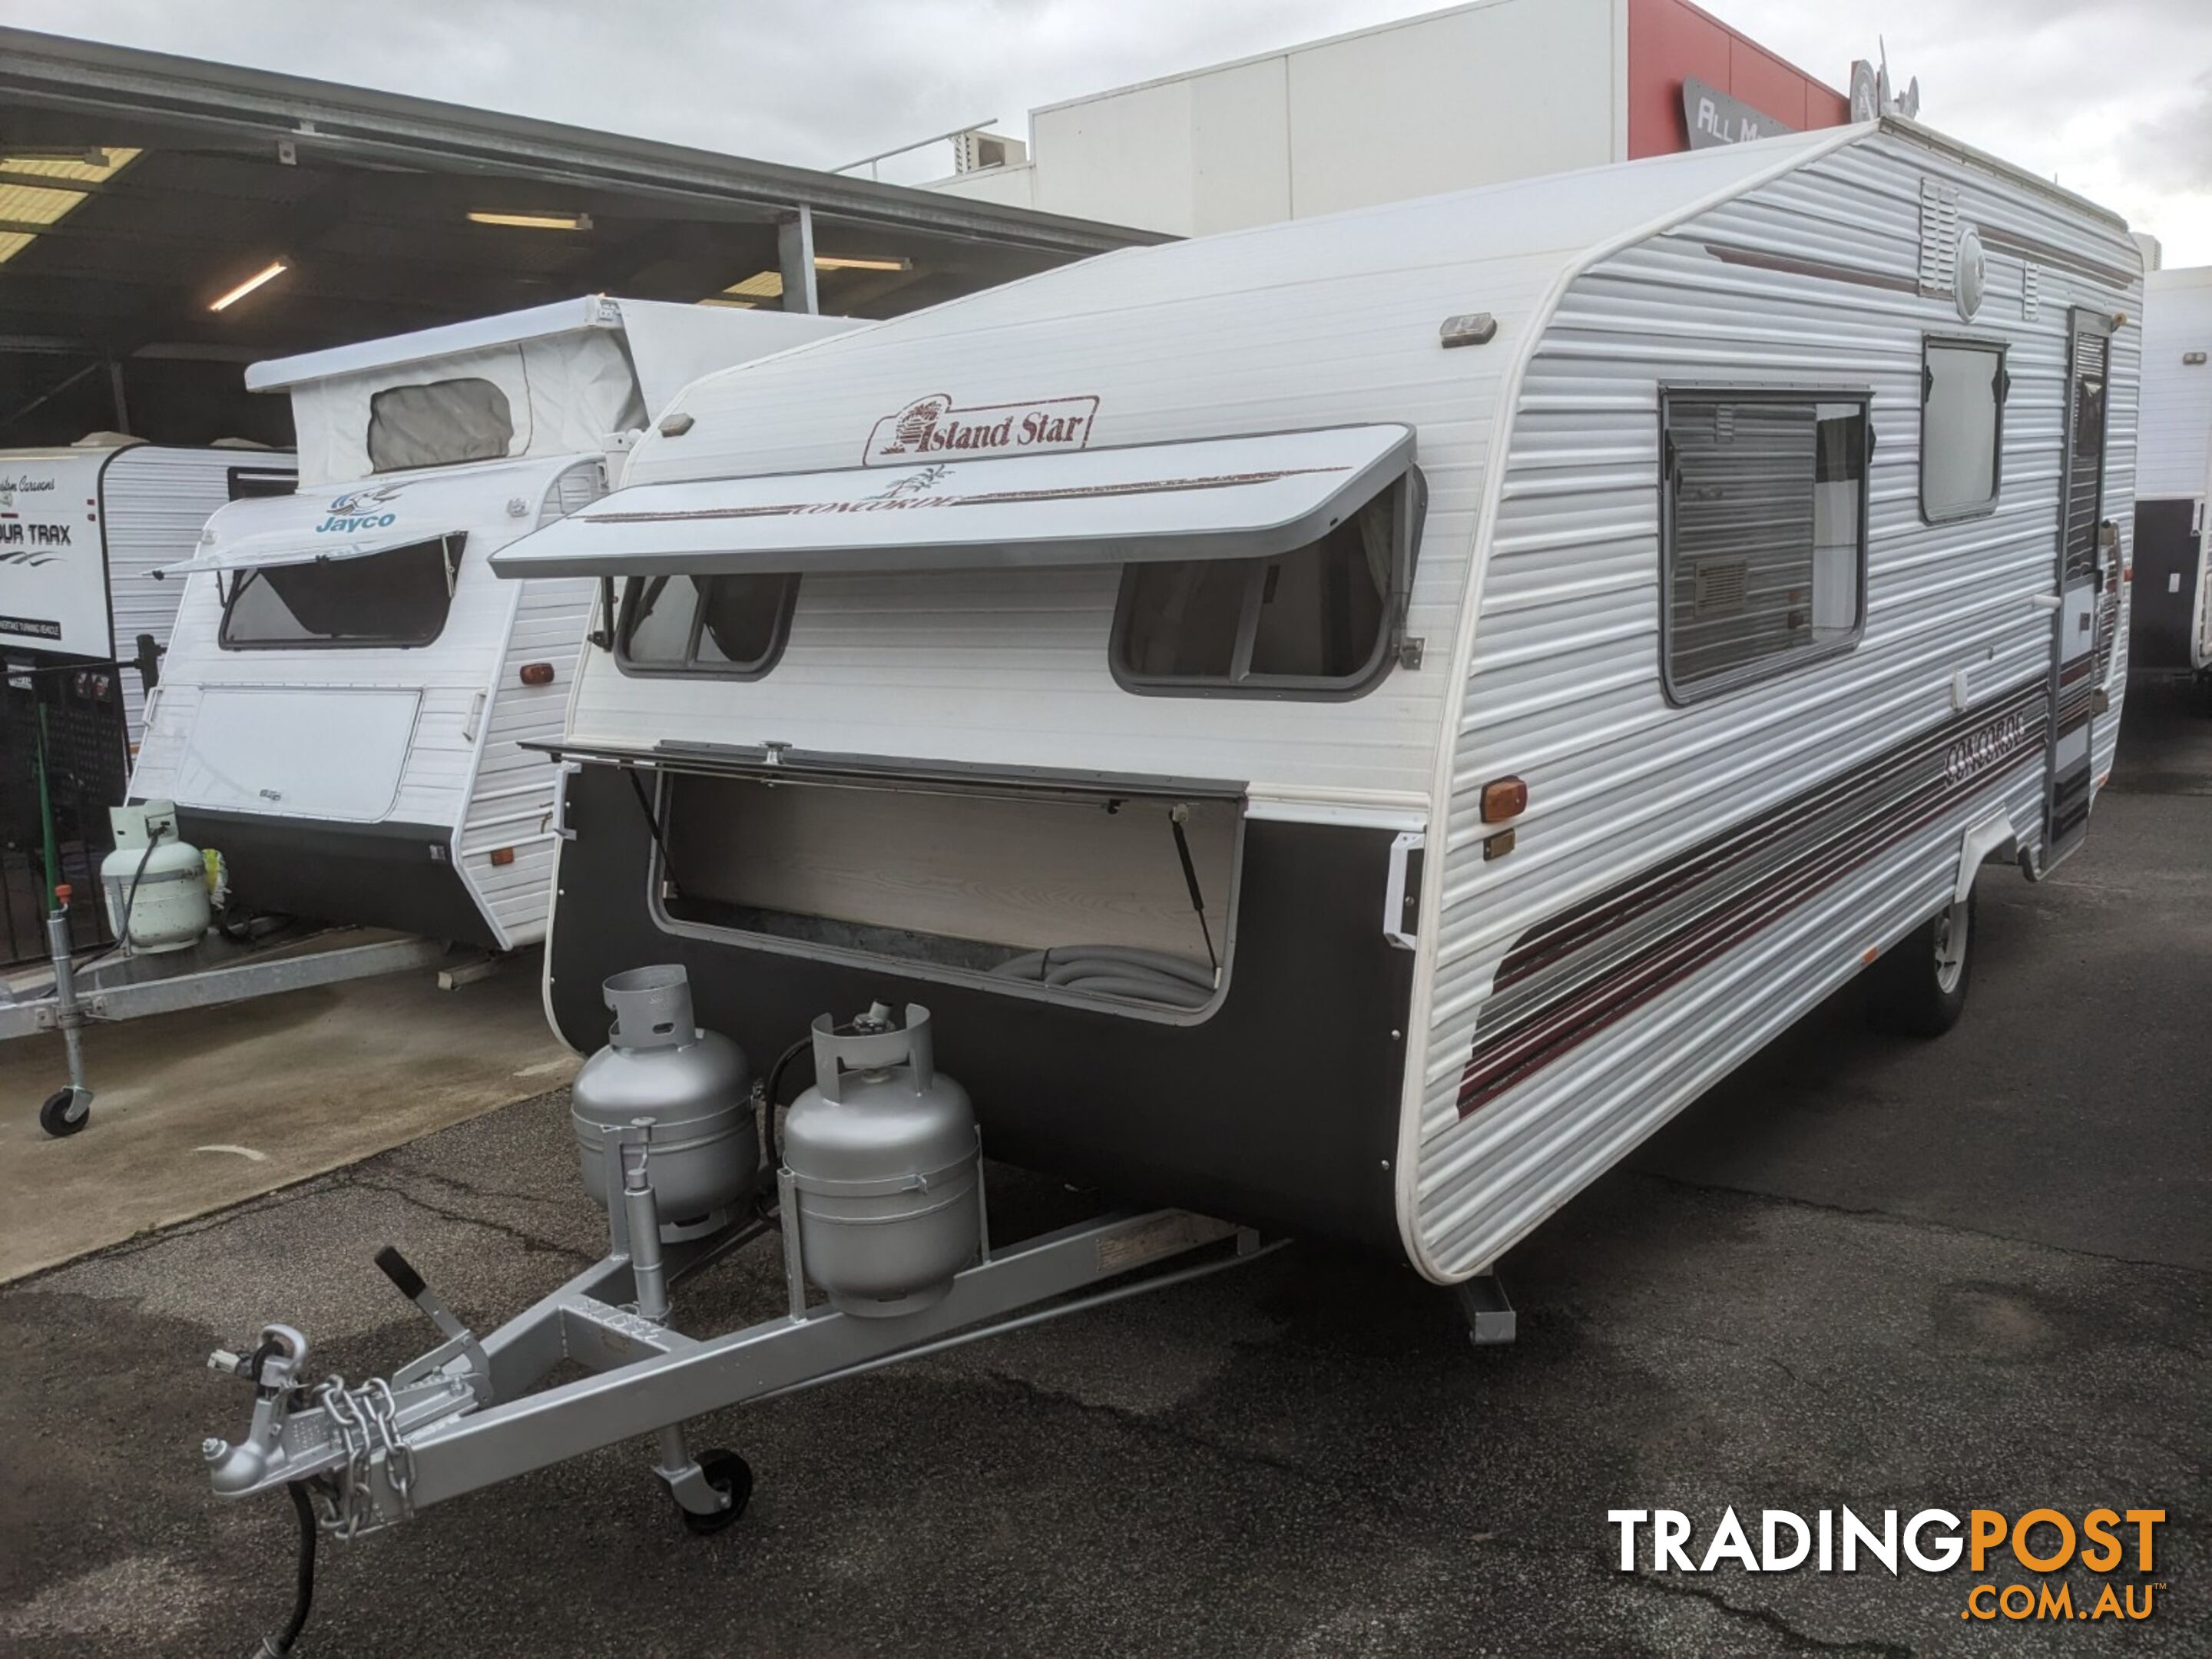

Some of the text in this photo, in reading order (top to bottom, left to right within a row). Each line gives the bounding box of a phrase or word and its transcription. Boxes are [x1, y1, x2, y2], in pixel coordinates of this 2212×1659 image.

[1697, 97, 1734, 144] ALL
[915, 412, 1083, 452] Island Star
[28, 524, 71, 545] TRAX
[316, 513, 396, 533] Jayco
